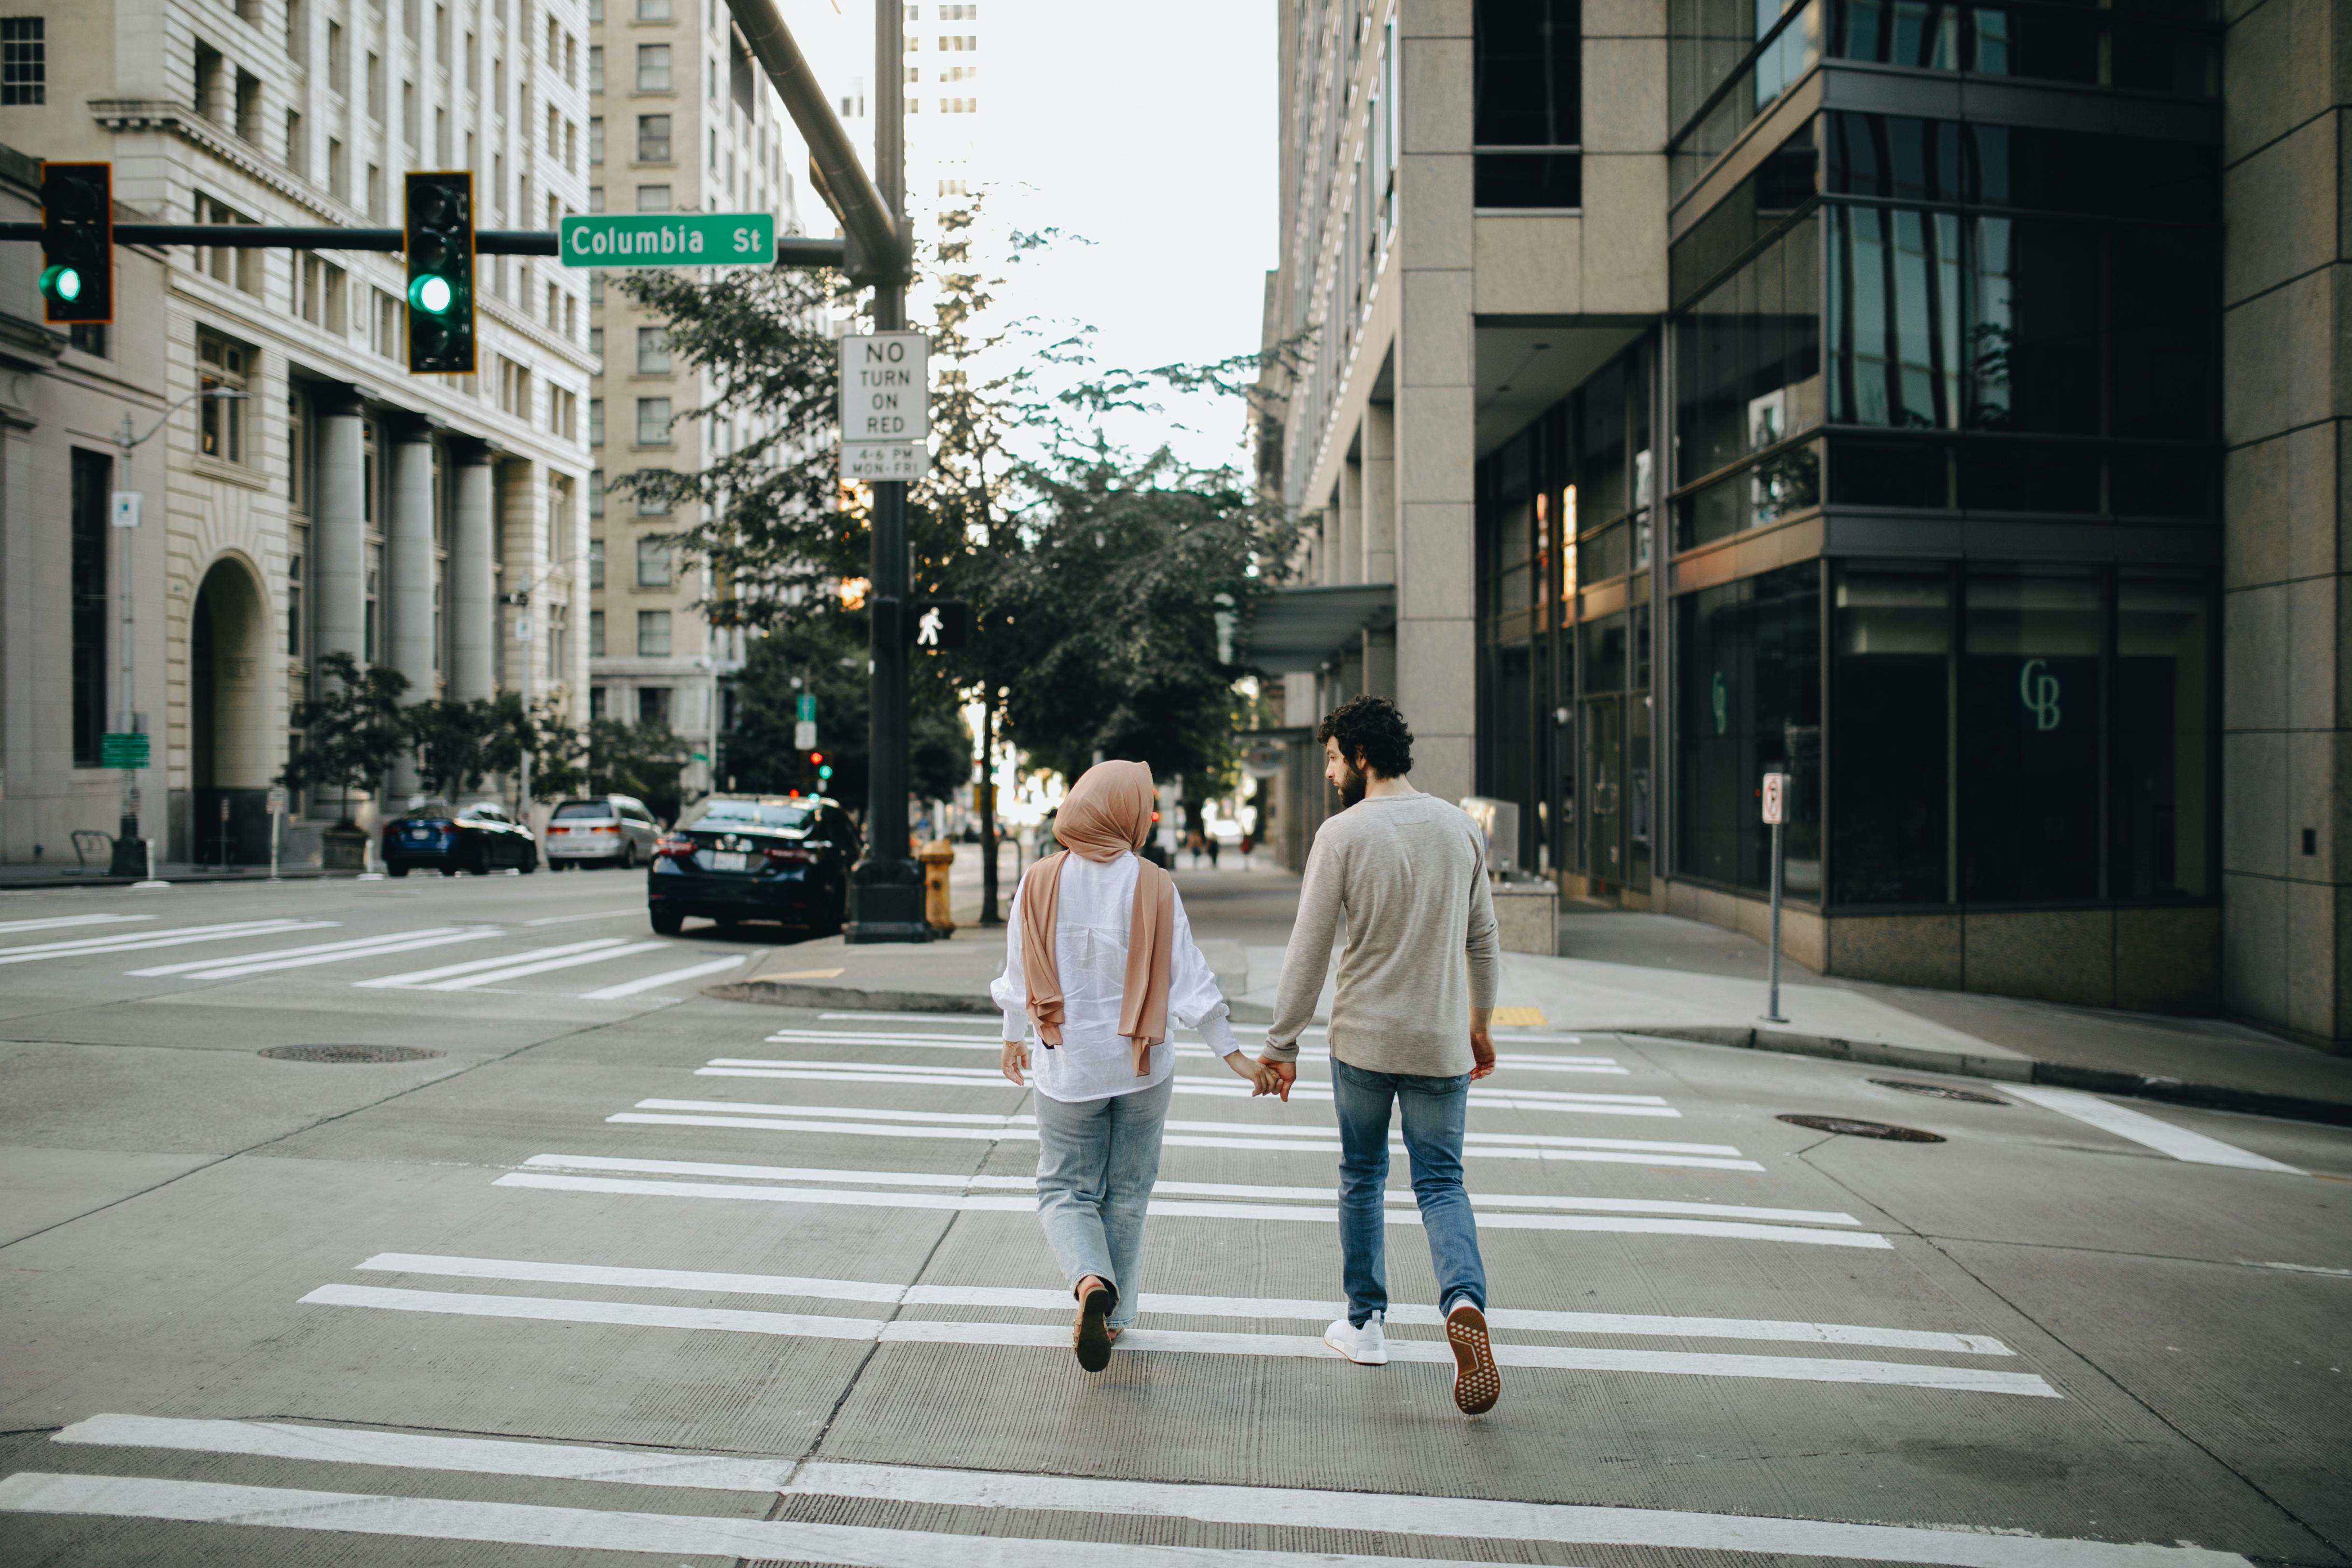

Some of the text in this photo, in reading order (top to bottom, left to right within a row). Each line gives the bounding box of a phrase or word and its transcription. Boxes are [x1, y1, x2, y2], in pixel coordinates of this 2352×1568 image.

[571, 224, 762, 255] Columbia St
[866, 342, 904, 363] NO
[859, 370, 910, 387] TURN
[872, 393, 898, 410] ON
[867, 416, 905, 433] RED
[859, 448, 913, 460] 4-6 PM
[852, 461, 919, 475] MON-FRI
